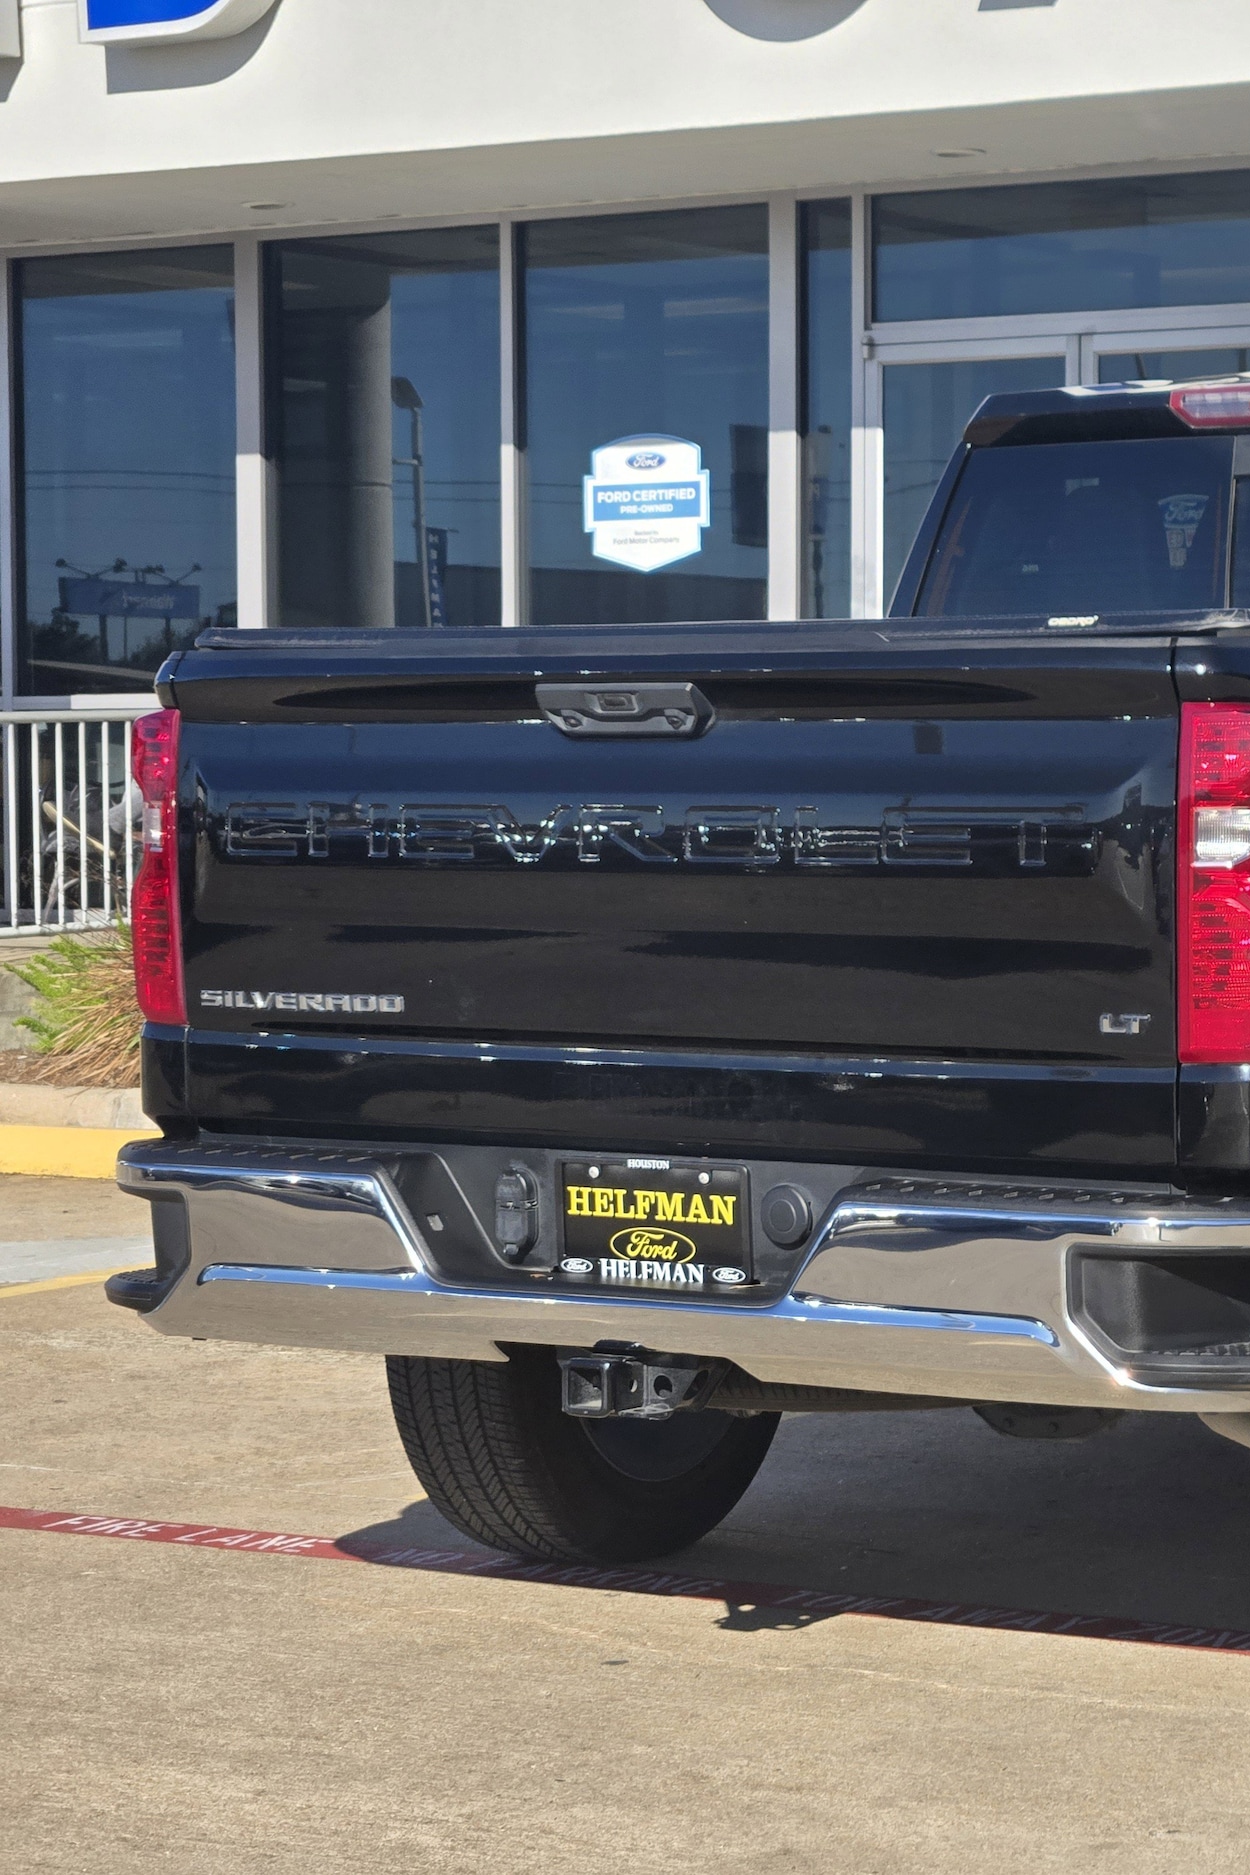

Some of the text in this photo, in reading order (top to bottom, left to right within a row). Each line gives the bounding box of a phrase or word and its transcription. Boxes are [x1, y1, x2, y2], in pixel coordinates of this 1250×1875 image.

[632, 453, 661, 468] Ford
[597, 487, 696, 503] FORD CERTIFIED
[620, 503, 674, 514] PRE-OWNED
[226, 801, 1086, 865] CHEVROLET
[200, 989, 405, 1013] SILVERADO
[1099, 1013, 1151, 1034] LT
[627, 1158, 670, 1170] HOUSTON
[566, 1186, 736, 1225] HELFMAN
[626, 1230, 680, 1260] Ford
[599, 1258, 705, 1284] HELFMAN
[717, 1269, 743, 1282] Ford
[42, 1514, 183, 1538] FIRE
[172, 1527, 335, 1553] LANE
